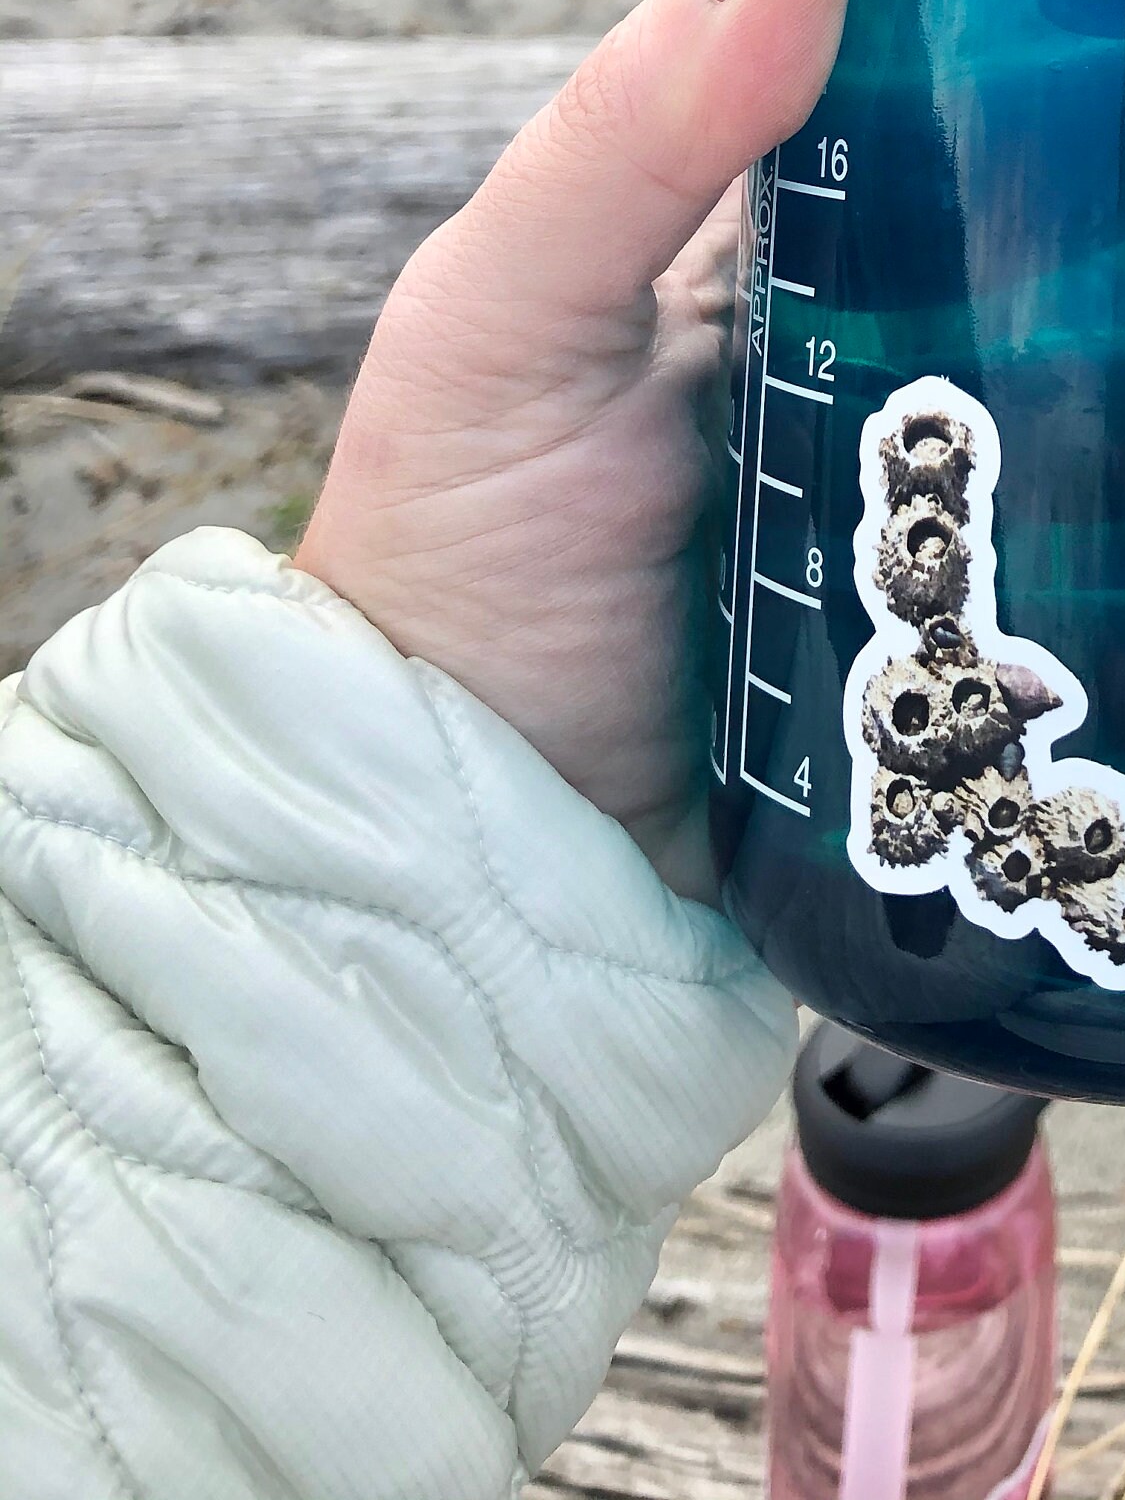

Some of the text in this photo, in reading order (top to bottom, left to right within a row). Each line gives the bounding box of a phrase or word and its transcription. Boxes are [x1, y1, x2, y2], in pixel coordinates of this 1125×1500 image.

[817, 136, 849, 182] 16
[750, 164, 775, 357] APPROX.
[805, 336, 837, 382] 12
[805, 547, 824, 589] 8
[793, 756, 812, 798] 4
